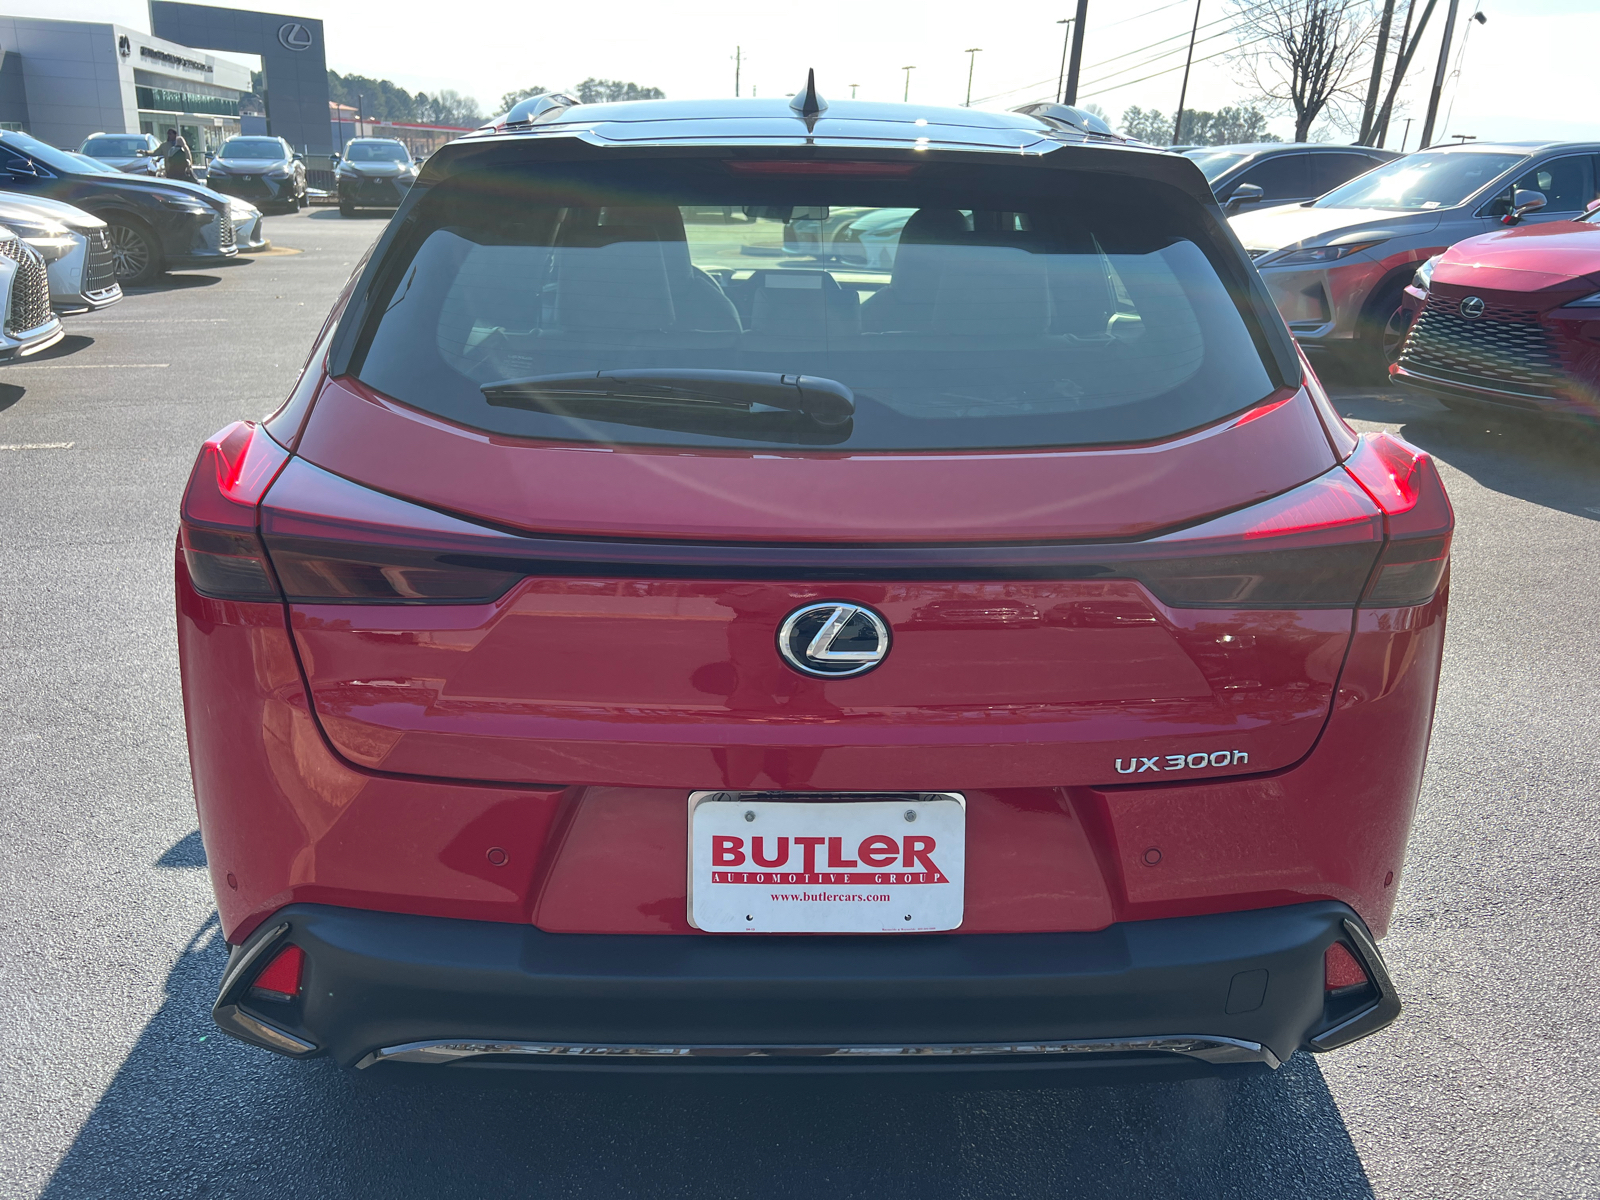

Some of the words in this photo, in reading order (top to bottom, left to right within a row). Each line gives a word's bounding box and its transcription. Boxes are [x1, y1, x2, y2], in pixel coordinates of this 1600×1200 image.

[1115, 756, 1160, 774] UX
[1163, 749, 1249, 771] 300h
[713, 872, 851, 884] AUTOMOTIVE
[874, 872, 942, 884] GROUP
[770, 892, 891, 903] www.butlercars.com
